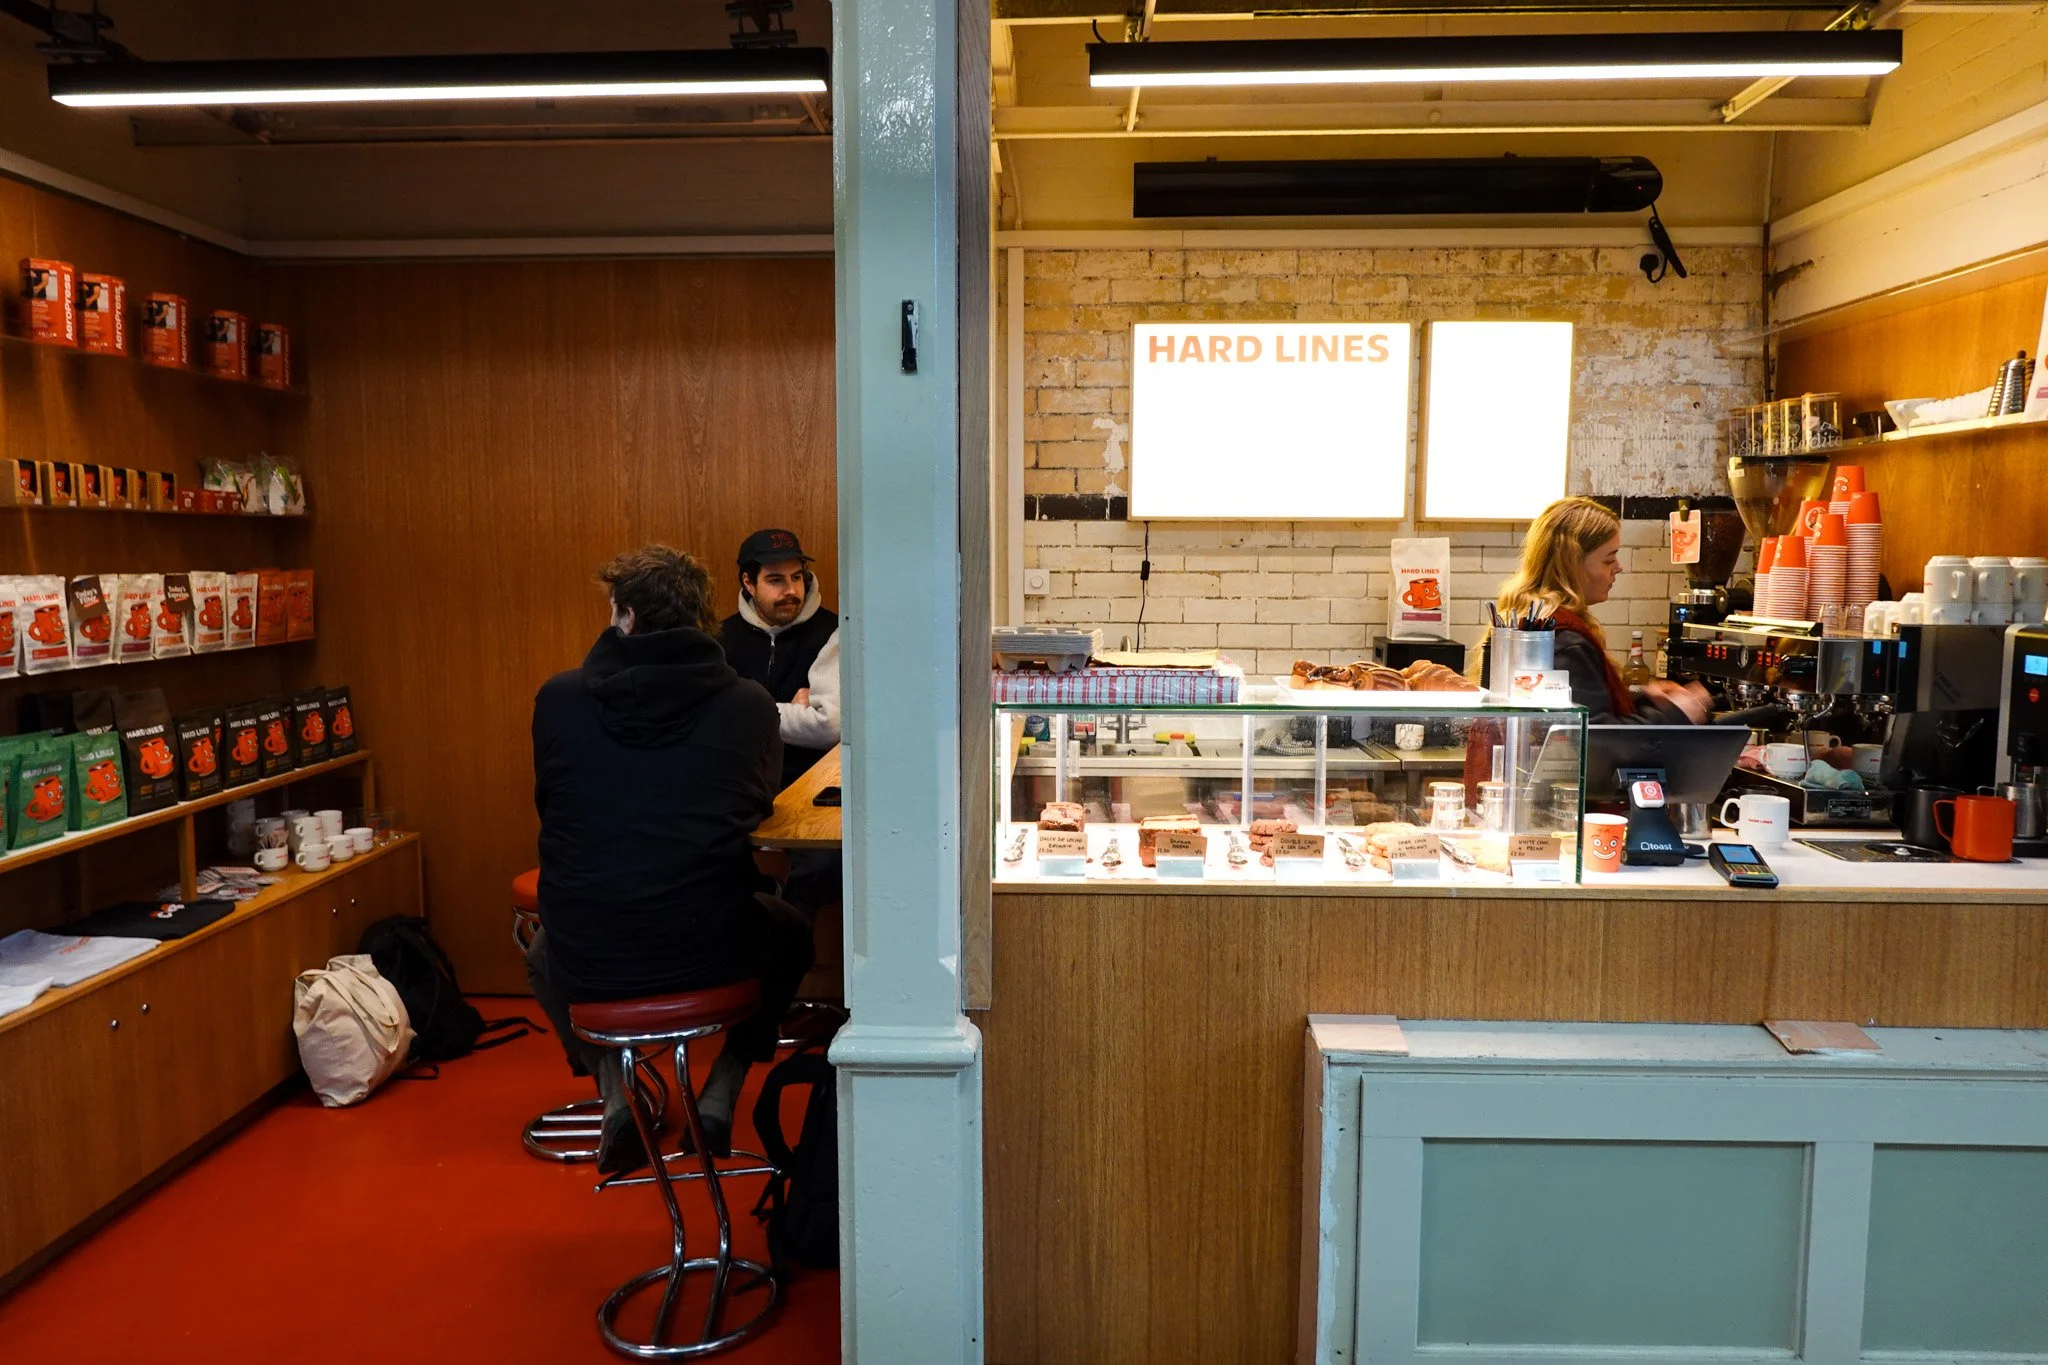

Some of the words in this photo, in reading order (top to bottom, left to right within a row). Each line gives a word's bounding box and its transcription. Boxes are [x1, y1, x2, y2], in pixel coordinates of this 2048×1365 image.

[1148, 335, 1263, 363] HARD
[1275, 334, 1389, 363] LINES
[22, 595, 42, 603] HARD
[42, 593, 60, 602] LINES
[126, 730, 146, 740] HARD
[145, 724, 165, 737] LINES
[1280, 837, 1301, 845] DOUBLE
[1650, 842, 1673, 851] toast
